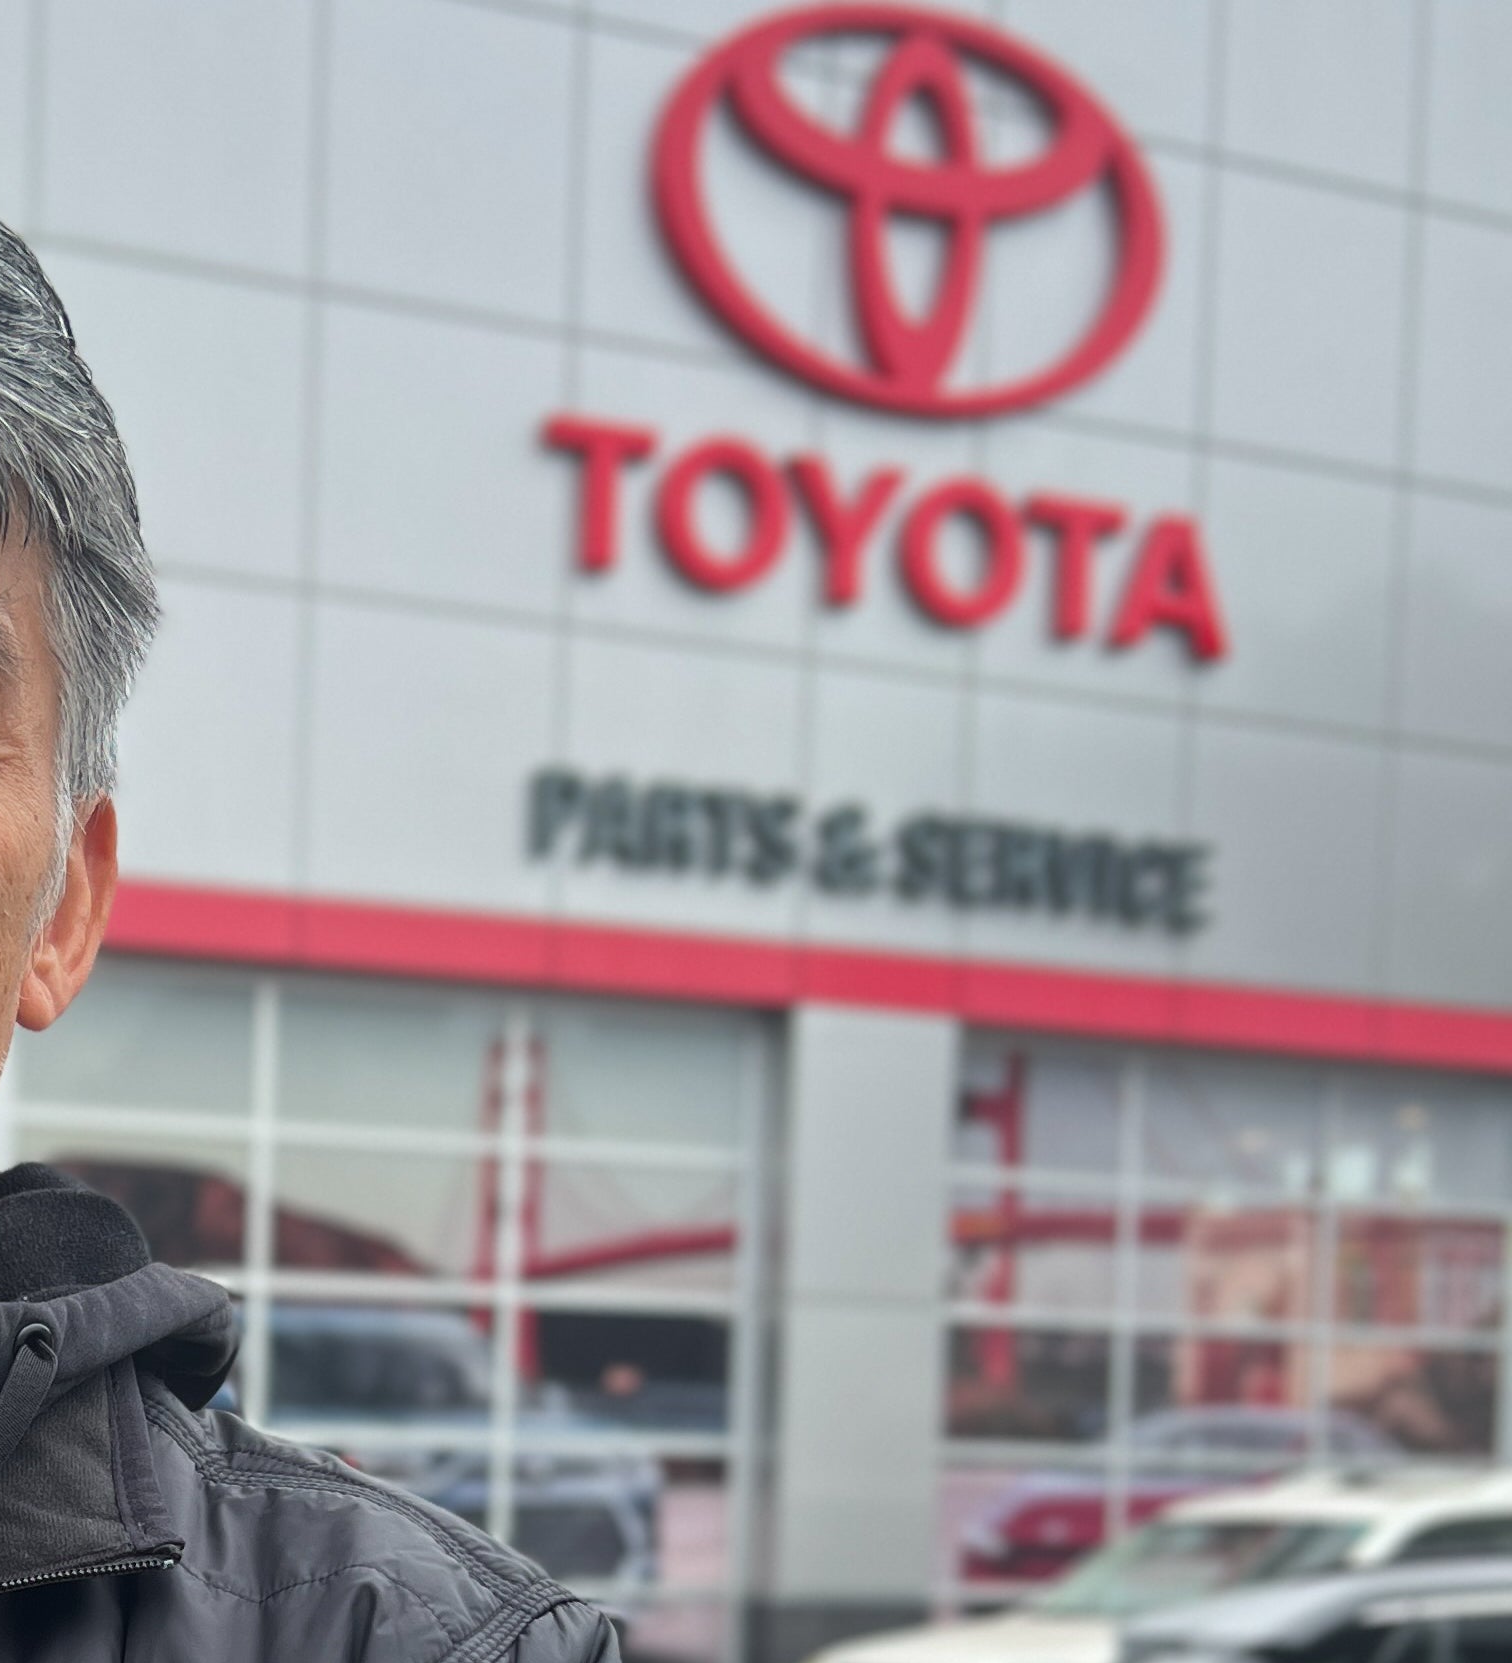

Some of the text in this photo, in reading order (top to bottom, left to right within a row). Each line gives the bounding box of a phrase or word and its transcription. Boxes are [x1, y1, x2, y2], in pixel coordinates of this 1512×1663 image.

[539, 412, 1230, 665] TOYOTA
[525, 767, 1214, 936] PARTS & SERVICE
